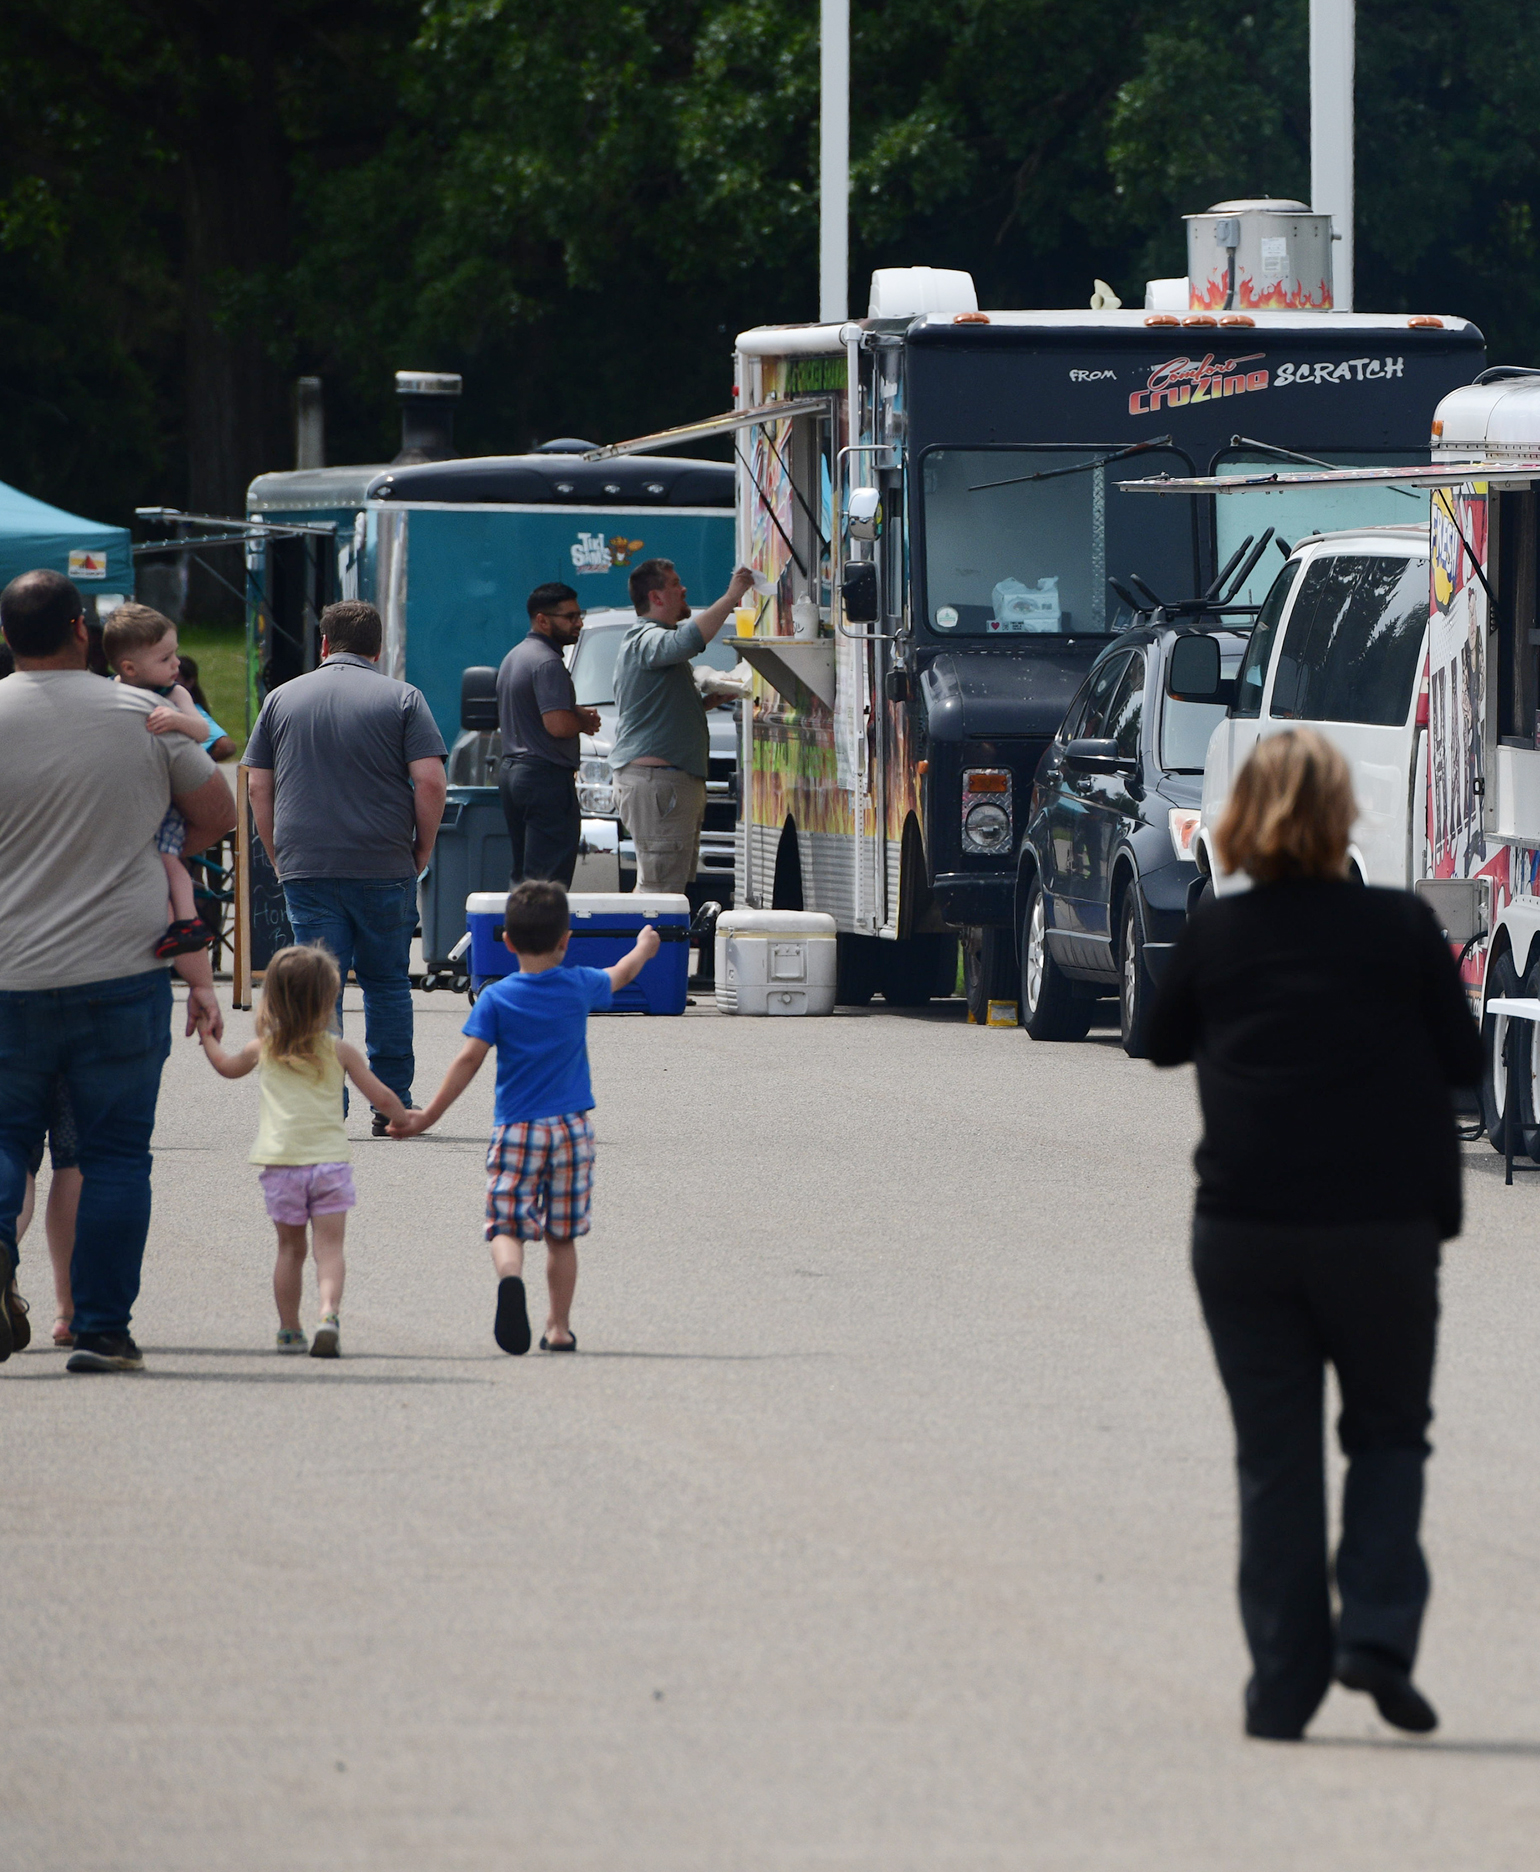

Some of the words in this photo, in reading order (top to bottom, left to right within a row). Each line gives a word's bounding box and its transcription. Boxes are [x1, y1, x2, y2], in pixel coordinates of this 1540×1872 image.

[1069, 368, 1117, 382] FROM
[1147, 353, 1266, 391] Comfort
[1273, 357, 1405, 387] SCRATCH
[1430, 503, 1459, 582] FRESH
